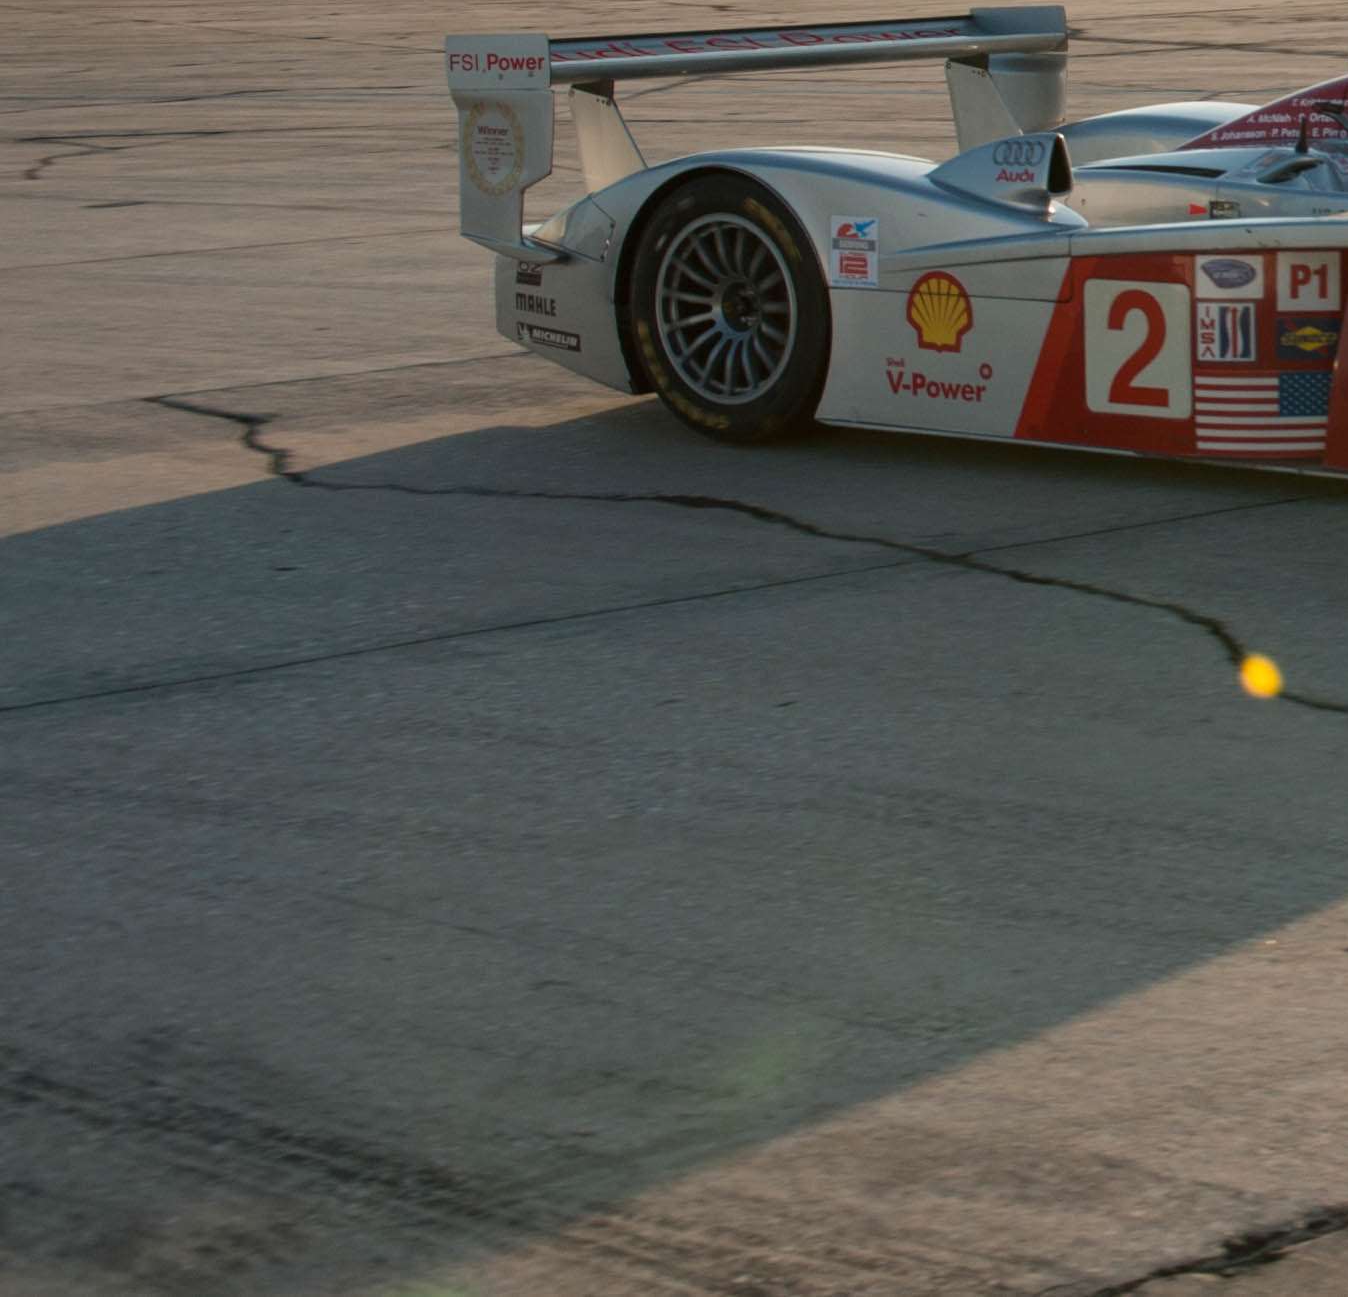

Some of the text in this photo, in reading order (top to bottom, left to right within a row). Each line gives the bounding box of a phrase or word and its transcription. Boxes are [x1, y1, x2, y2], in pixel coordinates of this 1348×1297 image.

[449, 52, 545, 72] FSI Power
[995, 168, 1035, 183] Audi
[1290, 263, 1329, 300] P1
[515, 291, 557, 318] MAHLE
[1107, 289, 1170, 408] 2
[885, 369, 988, 404] V-Power
